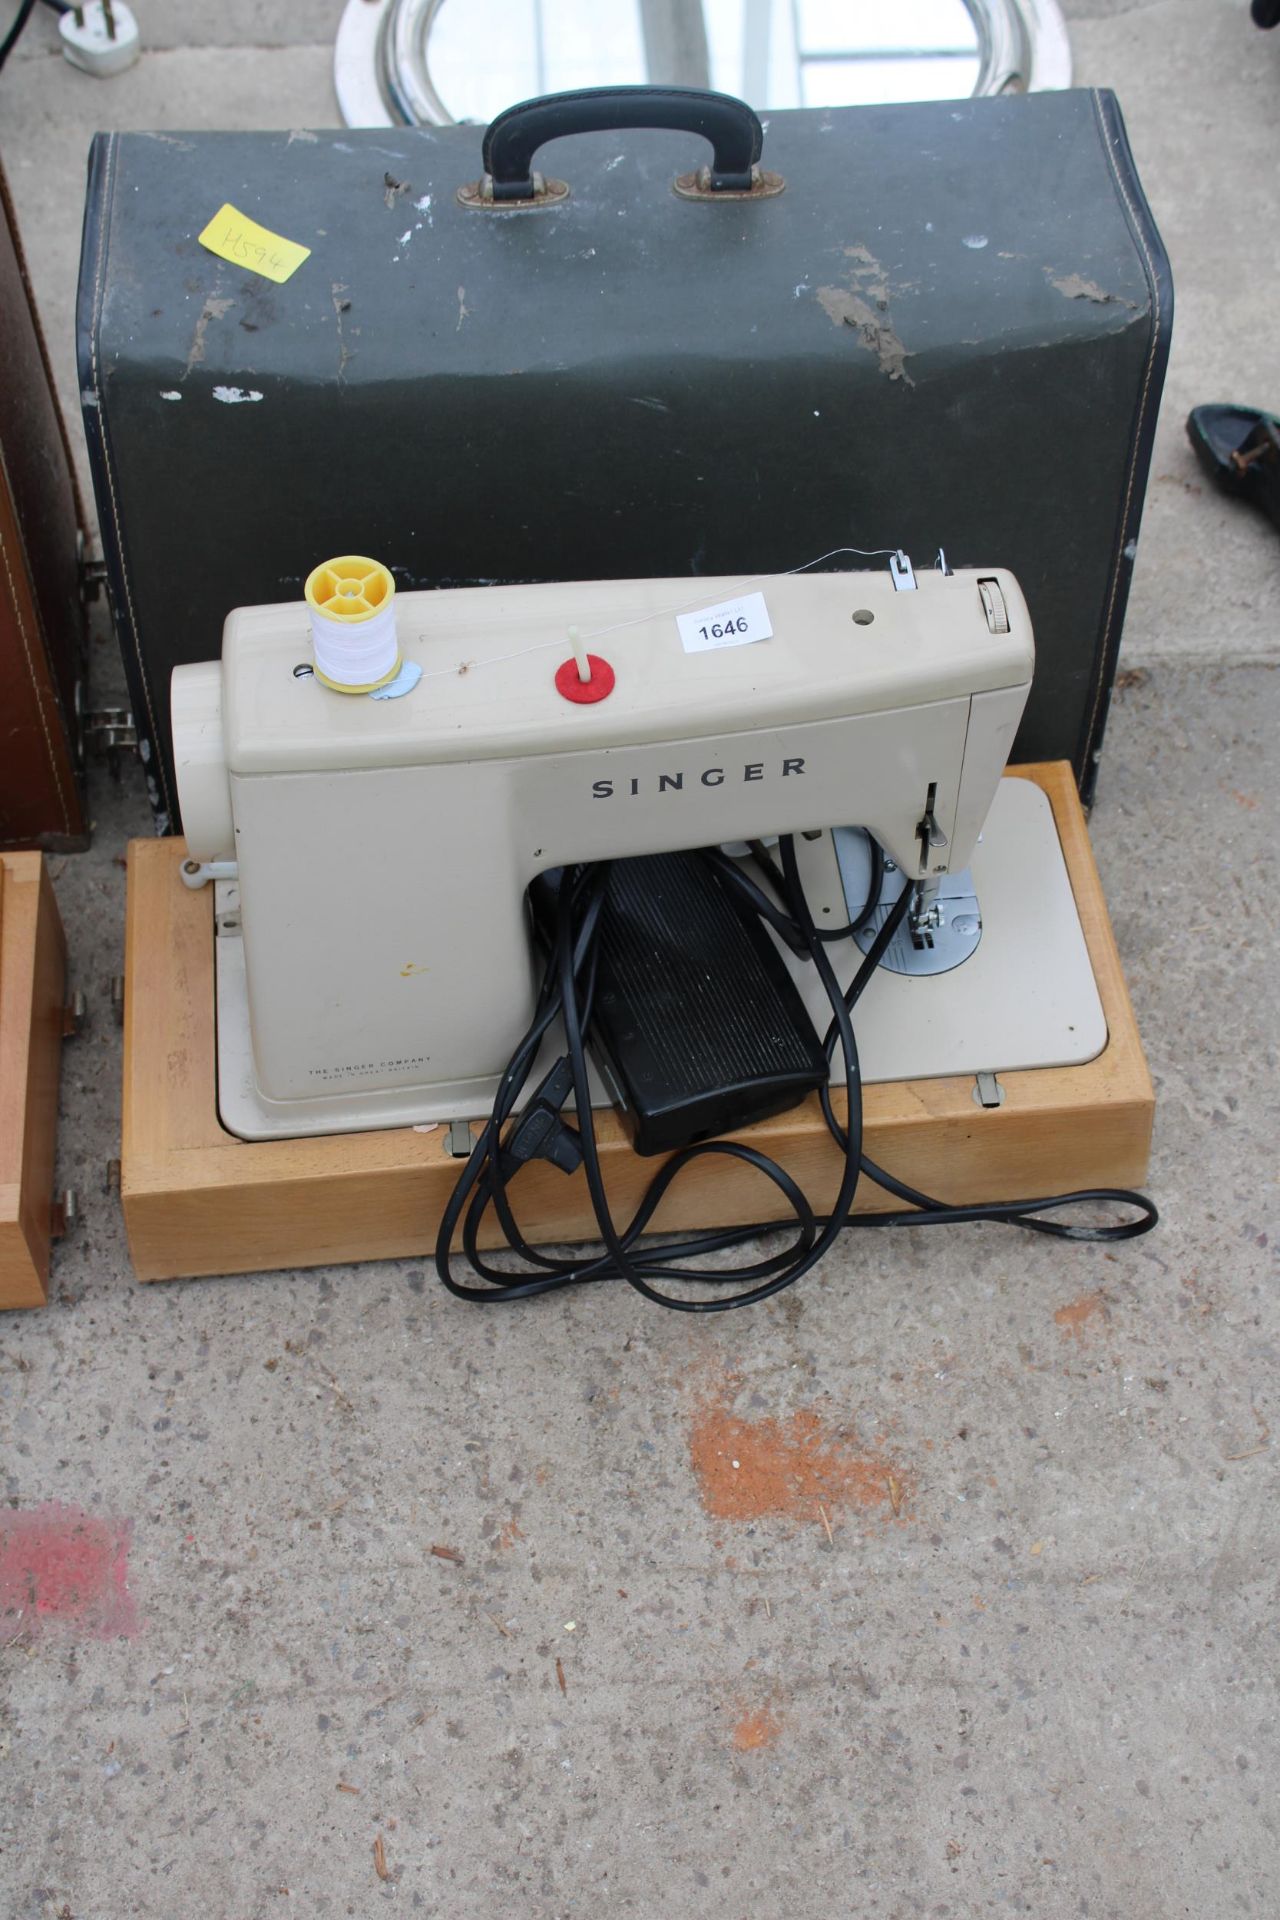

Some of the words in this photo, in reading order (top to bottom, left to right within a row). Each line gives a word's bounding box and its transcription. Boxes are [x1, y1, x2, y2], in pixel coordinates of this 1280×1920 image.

[698, 616, 748, 640] 1646
[591, 757, 806, 799] SINGER
[308, 1068, 328, 1076] THE
[334, 1063, 374, 1073] SINGER
[380, 1056, 431, 1068] COMPANY
